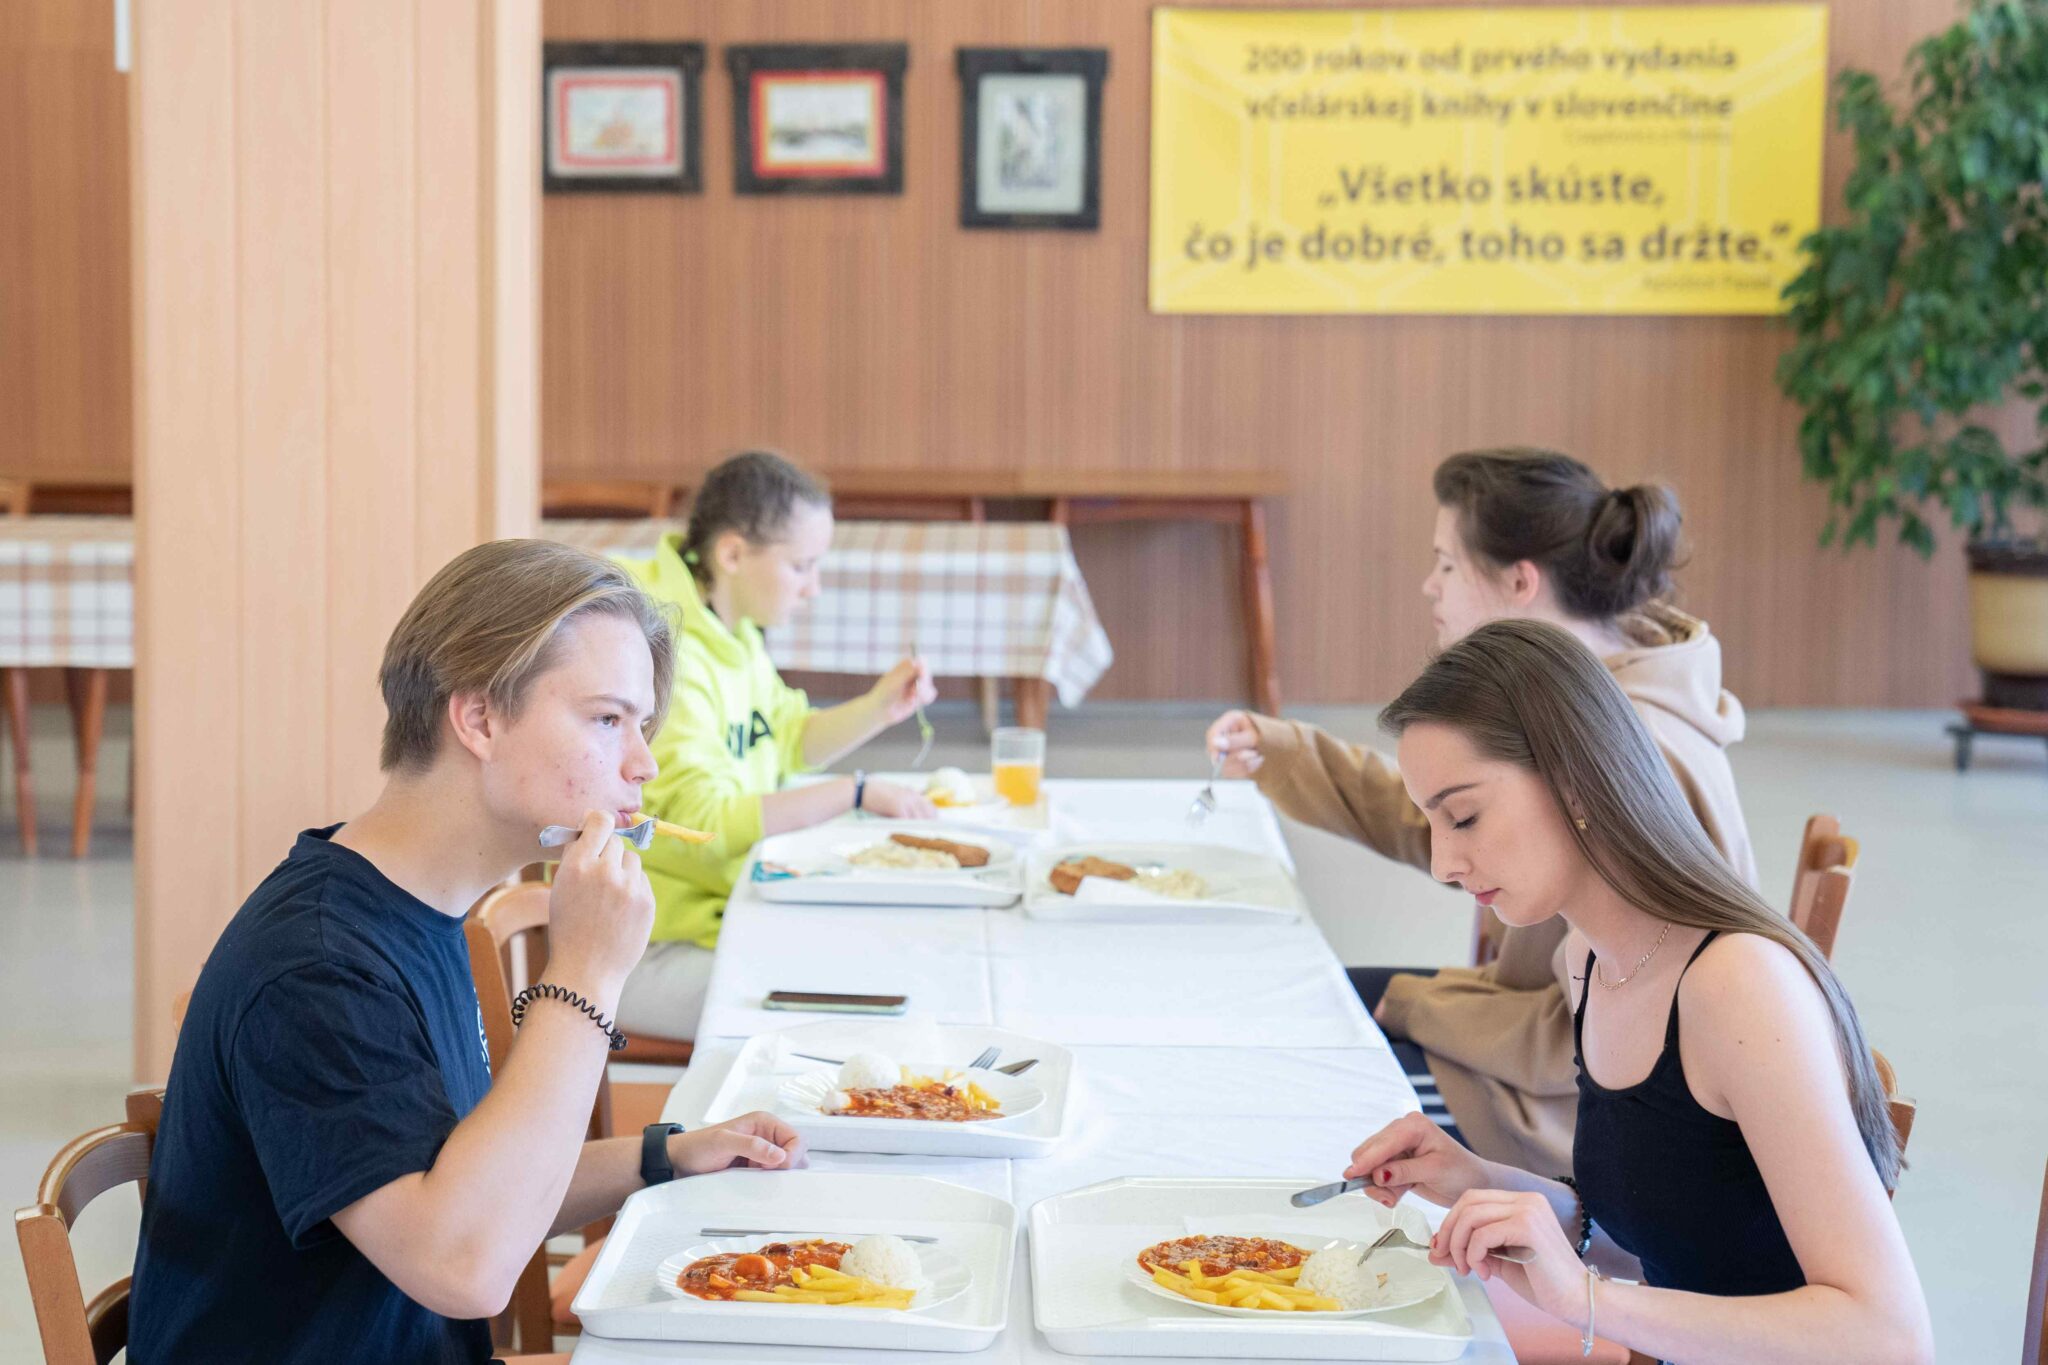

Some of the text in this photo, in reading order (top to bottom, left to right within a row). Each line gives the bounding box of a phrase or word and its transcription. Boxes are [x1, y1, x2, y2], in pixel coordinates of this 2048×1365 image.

[1246, 44, 1737, 76] 200 rokov od prvého vydania
[1423, 93, 1513, 124] knihy
[1524, 101, 1543, 117] v
[1554, 92, 1733, 118] slovenčine
[1506, 166, 1664, 207] skúste,
[1184, 226, 1235, 261] čo
[1246, 229, 1287, 271] je
[1299, 224, 1446, 266] dobré,
[1460, 225, 1566, 261] toho
[1580, 236, 1626, 261] sa
